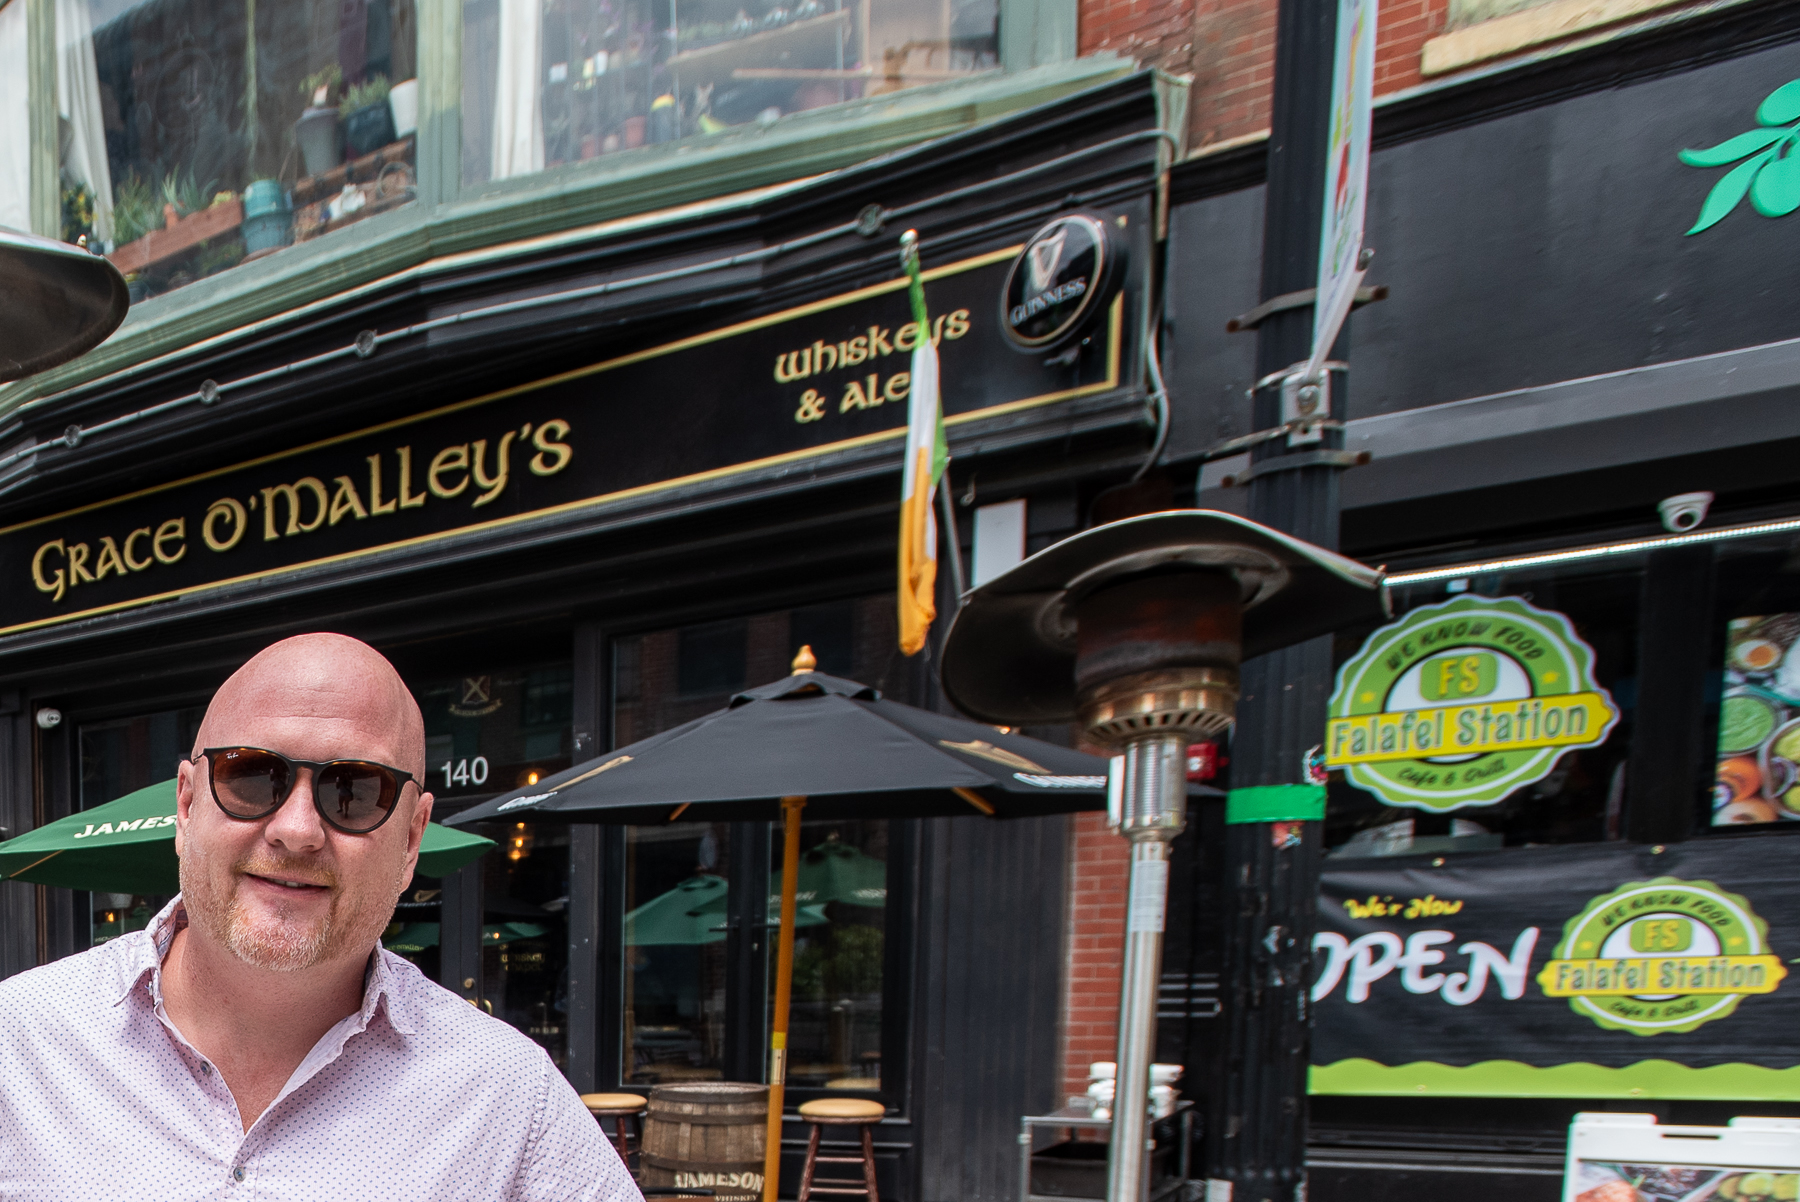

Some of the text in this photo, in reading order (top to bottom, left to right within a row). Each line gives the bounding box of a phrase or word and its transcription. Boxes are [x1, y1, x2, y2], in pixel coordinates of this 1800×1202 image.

[1009, 277, 1087, 328] GUINNESS
[794, 388, 827, 425] &
[1386, 619, 1548, 672] WE KNOW FOOD
[1438, 654, 1482, 698] FS
[1331, 700, 1589, 759] Falafel Station
[440, 755, 489, 789] 140
[73, 814, 178, 839] JAMES
[1403, 894, 1465, 920] Now
[1688, 898, 1734, 927] FOOD
[1643, 920, 1681, 949] FS
[1310, 926, 1540, 1006] OPEN
[1555, 955, 1766, 991] Falafel Station
[674, 1171, 766, 1193] JAMESON
